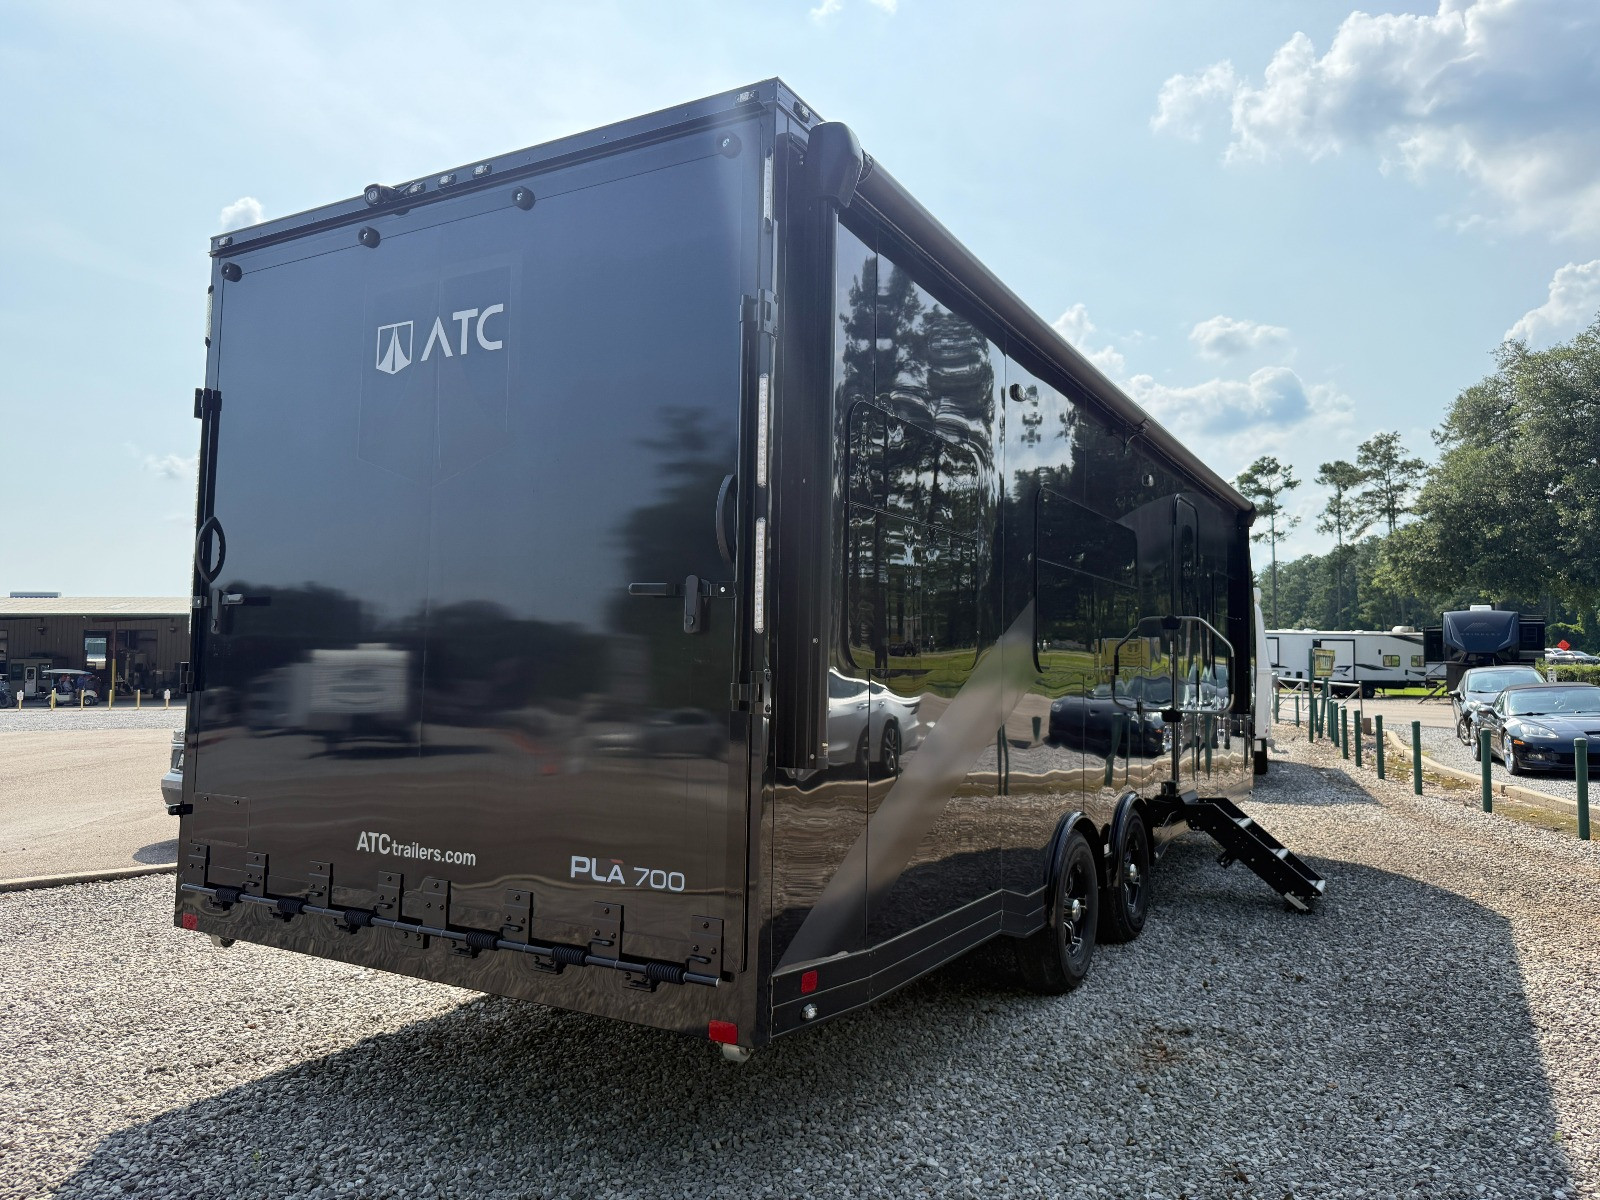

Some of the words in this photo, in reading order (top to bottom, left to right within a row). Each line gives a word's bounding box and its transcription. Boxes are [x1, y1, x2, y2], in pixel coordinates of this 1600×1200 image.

[420, 303, 504, 362] ATC
[356, 830, 477, 867] ATCtrailers.com
[570, 855, 626, 885] PLA
[633, 866, 685, 892] 700
